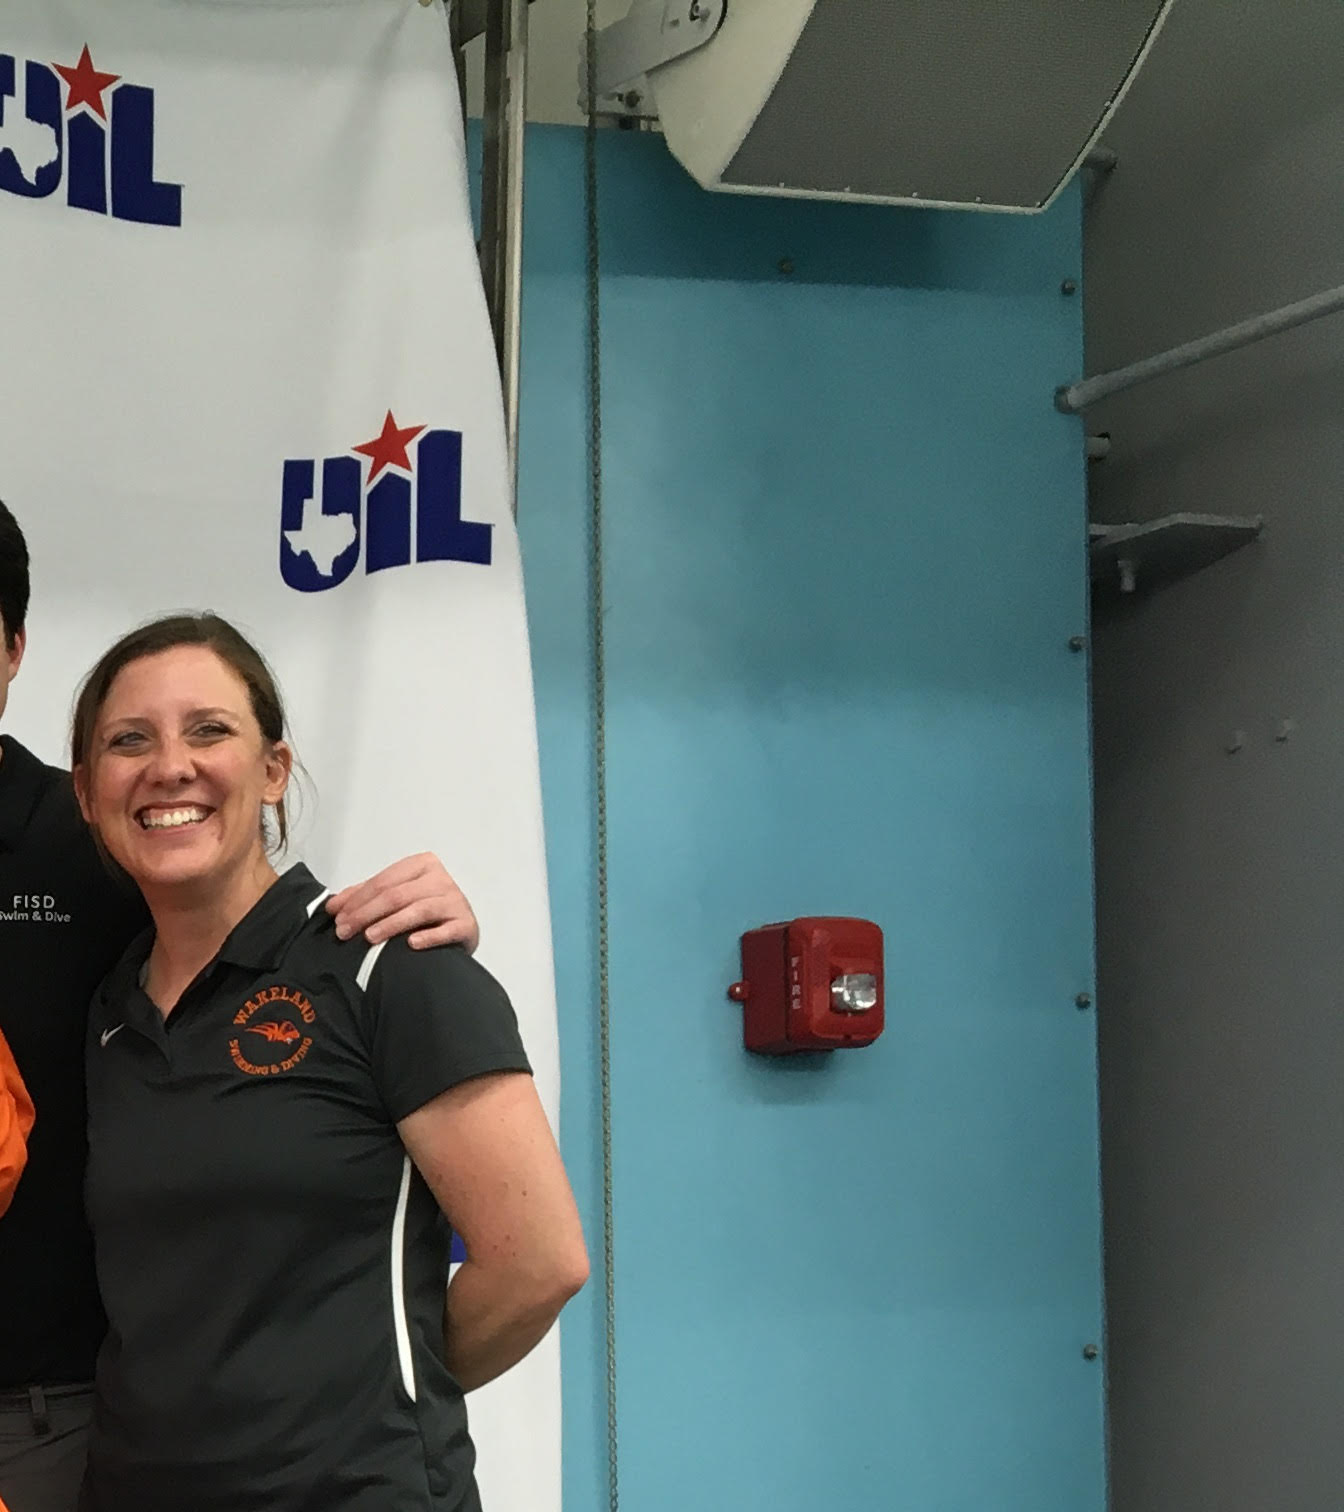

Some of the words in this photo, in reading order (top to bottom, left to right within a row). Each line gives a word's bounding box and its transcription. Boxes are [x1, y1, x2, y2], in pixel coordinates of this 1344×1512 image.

[279, 408, 492, 593] UIL
[13, 895, 55, 909] FISD
[32, 911, 42, 921] &
[45, 911, 71, 922] Dive
[791, 956, 801, 1009] FIRE
[233, 987, 316, 1025] WAKELAND
